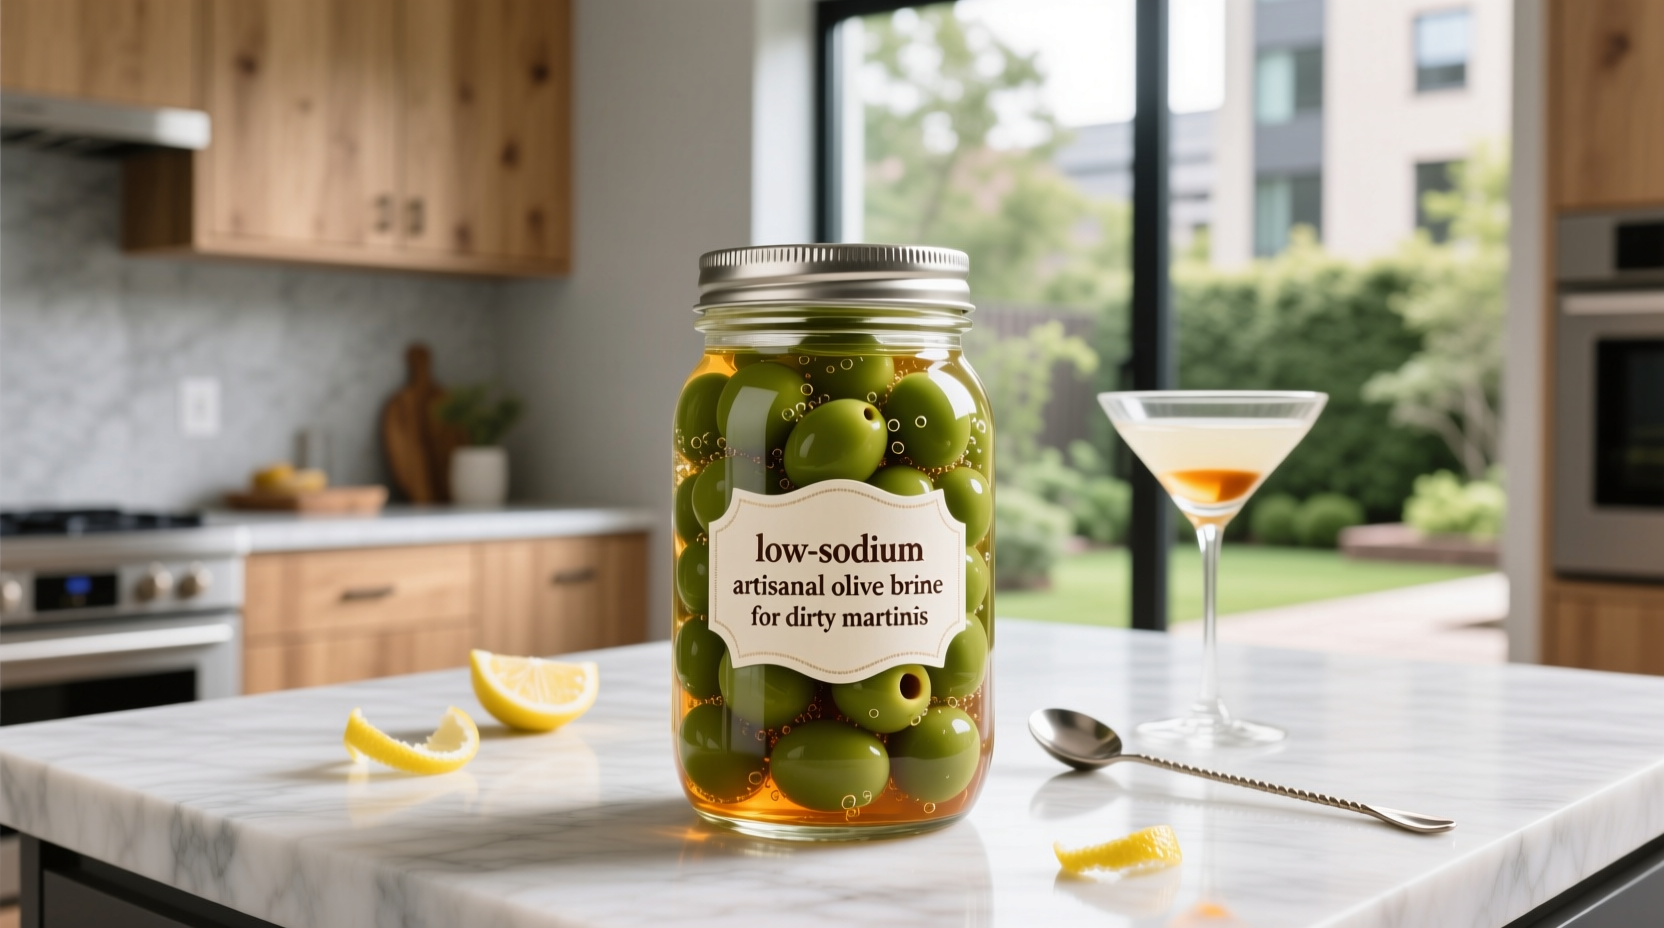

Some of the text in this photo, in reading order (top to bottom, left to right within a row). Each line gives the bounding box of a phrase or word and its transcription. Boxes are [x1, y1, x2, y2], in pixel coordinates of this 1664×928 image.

[755, 532, 924, 564] low-sodium
[732, 573, 944, 597] artisanal olive brine
[750, 604, 929, 633] for dirty martinis
